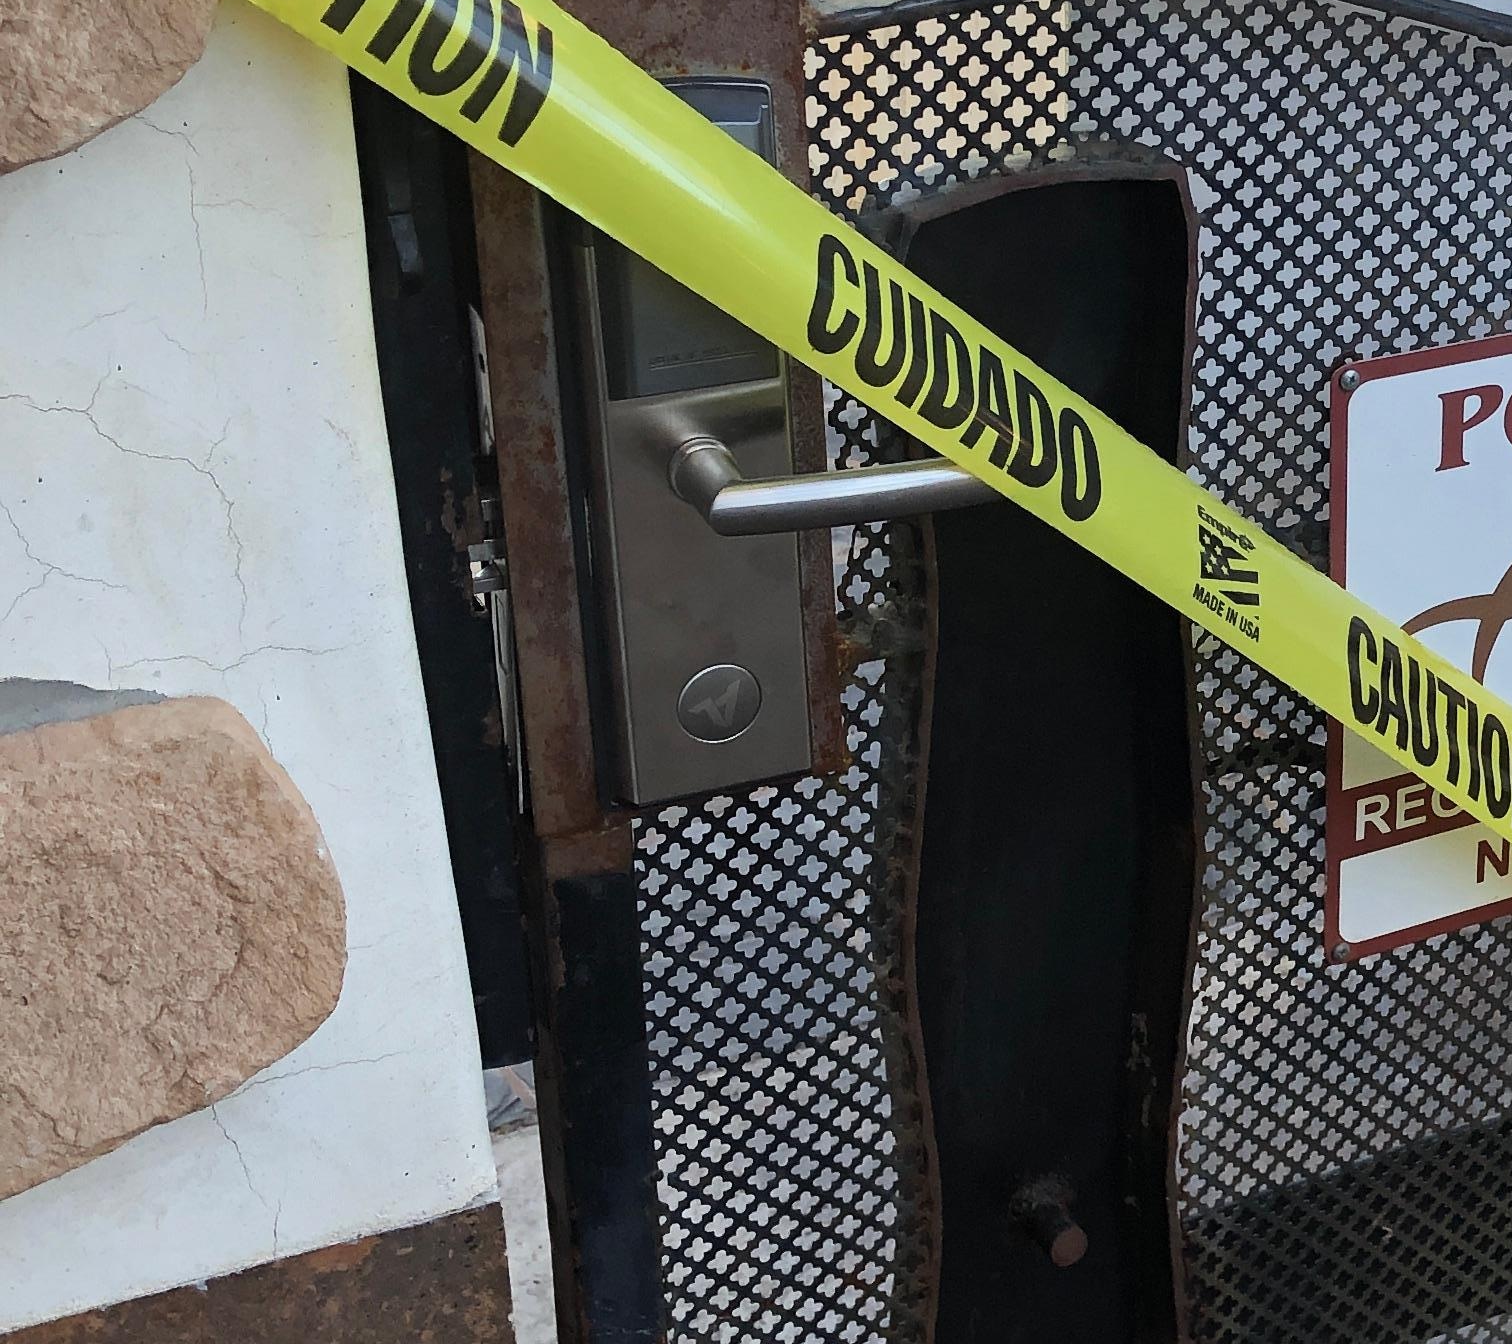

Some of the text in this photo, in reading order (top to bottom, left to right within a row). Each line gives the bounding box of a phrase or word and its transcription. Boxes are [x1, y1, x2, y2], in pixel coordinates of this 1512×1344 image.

[807, 234, 1101, 521] CUIDADO
[1192, 583, 1260, 643] MADE IN USA
